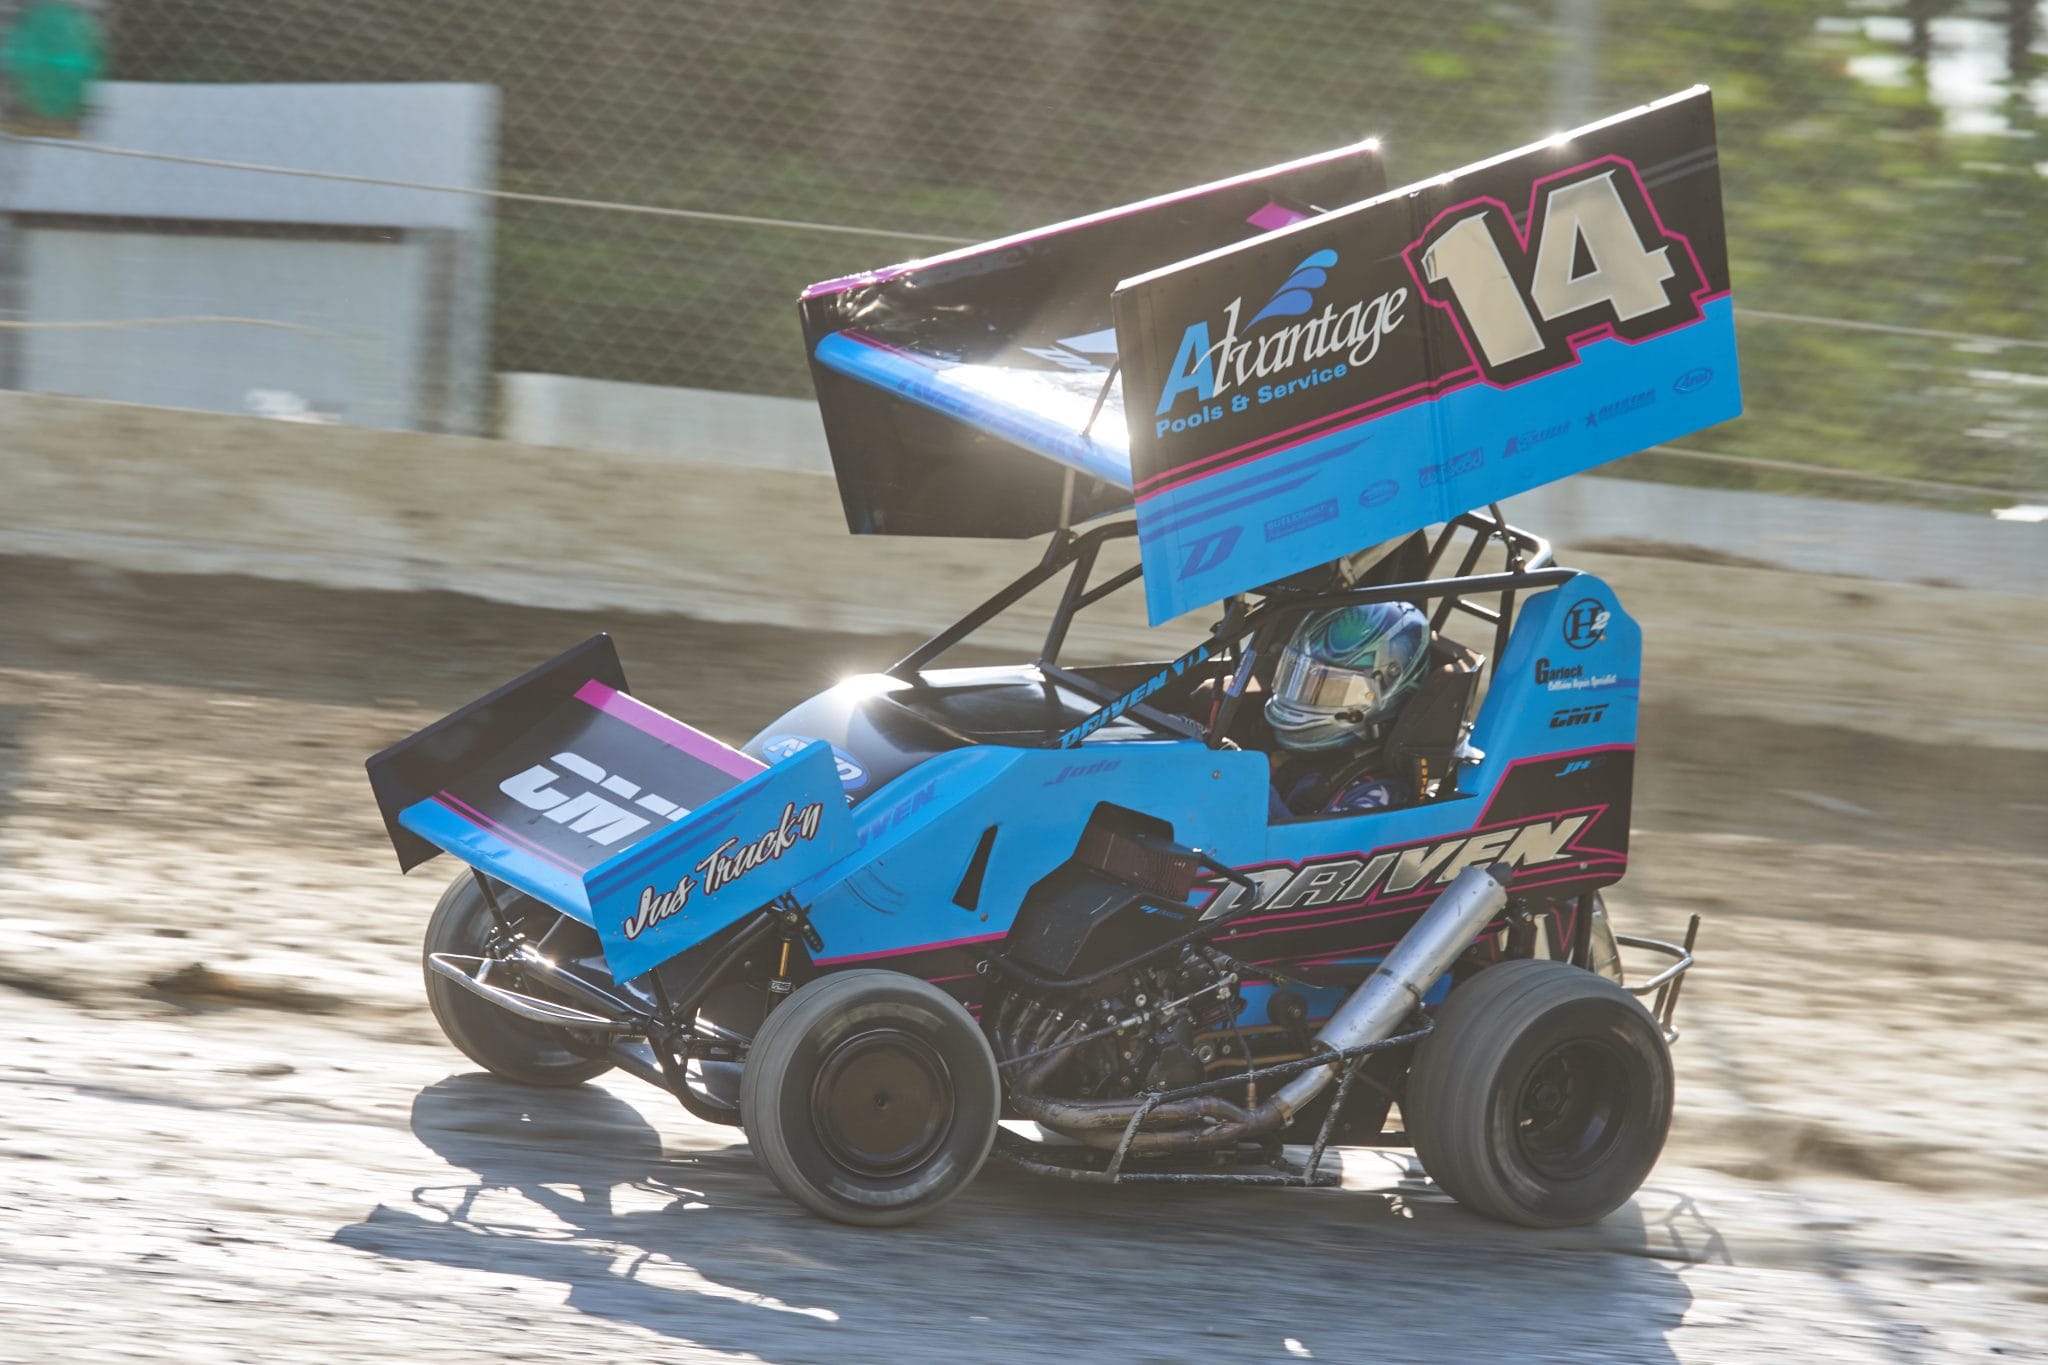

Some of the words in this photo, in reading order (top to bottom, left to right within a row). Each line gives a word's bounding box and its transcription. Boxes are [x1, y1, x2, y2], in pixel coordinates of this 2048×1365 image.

[1421, 169, 1675, 367] 14
[1155, 407, 1224, 439] Pools
[1231, 394, 1250, 412] &
[1257, 364, 1349, 403] Service
[624, 874, 698, 941] Jus
[1198, 815, 1588, 922] DRIVEN
